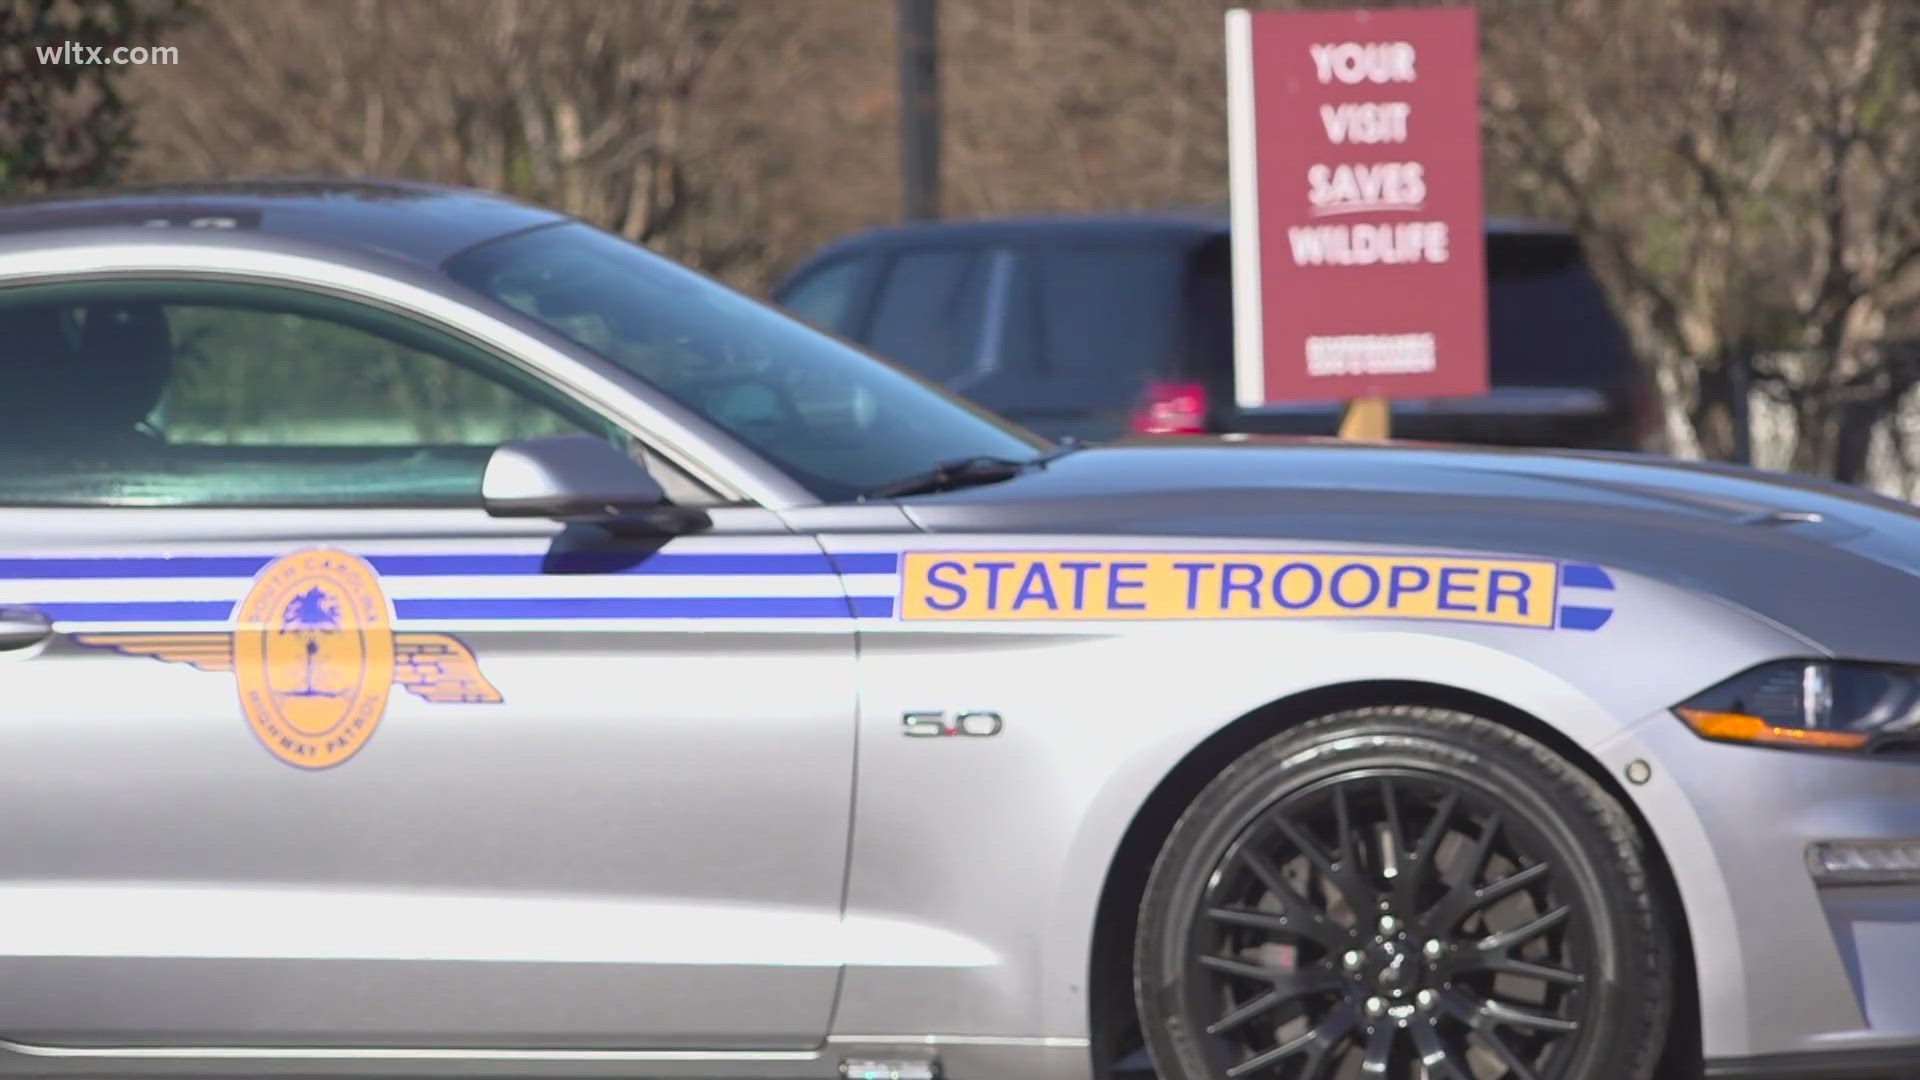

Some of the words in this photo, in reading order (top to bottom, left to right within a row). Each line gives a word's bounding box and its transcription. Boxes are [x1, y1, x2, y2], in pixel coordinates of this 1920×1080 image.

[1309, 41, 1417, 84] YOUR
[1320, 102, 1411, 144] VISIT
[1308, 162, 1427, 207] SAVES
[1287, 222, 1449, 266] WILDLIFE
[924, 560, 1147, 611] STATE
[1173, 562, 1533, 616] TROOPER
[902, 711, 1004, 739] 5.0
